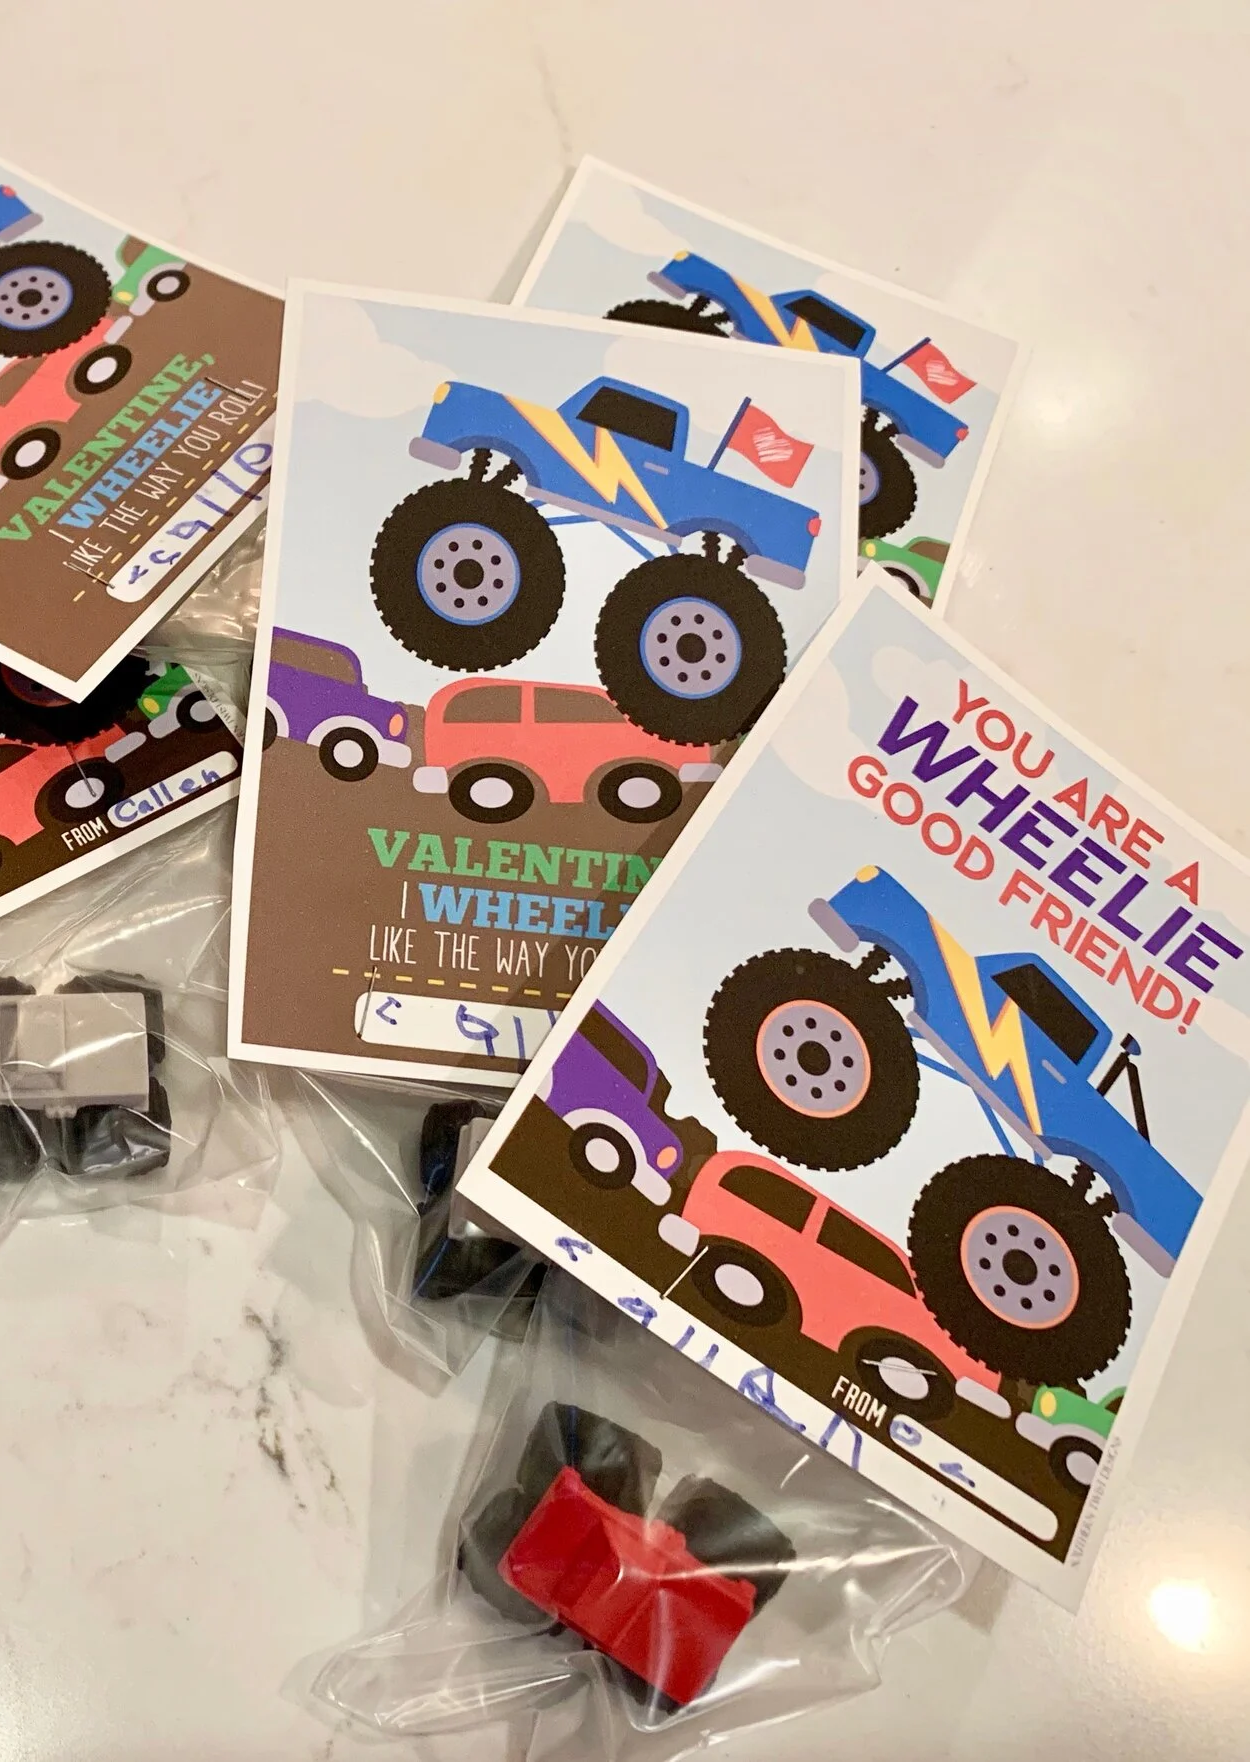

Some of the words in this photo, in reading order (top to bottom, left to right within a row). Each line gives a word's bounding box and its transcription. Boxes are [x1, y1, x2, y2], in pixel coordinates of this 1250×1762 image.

[57, 380, 223, 529] WHEELIE
[99, 501, 149, 534] THE
[134, 461, 185, 501] WAY
[172, 424, 222, 461] YOU
[60, 817, 110, 851] FROM
[877, 694, 1245, 994] WHEELIE
[951, 679, 1055, 779] YOU
[1052, 777, 1166, 871] ARE
[1164, 860, 1200, 907] A
[401, 881, 408, 919] I
[418, 882, 630, 940] WHEEL
[847, 755, 996, 881] GOOD
[998, 868, 1202, 1036] FRIEND!
[369, 924, 417, 965] LIKE
[433, 930, 480, 972] THE
[496, 937, 549, 978] WAY
[565, 945, 602, 981] YO
[830, 1375, 888, 1429] FROM
